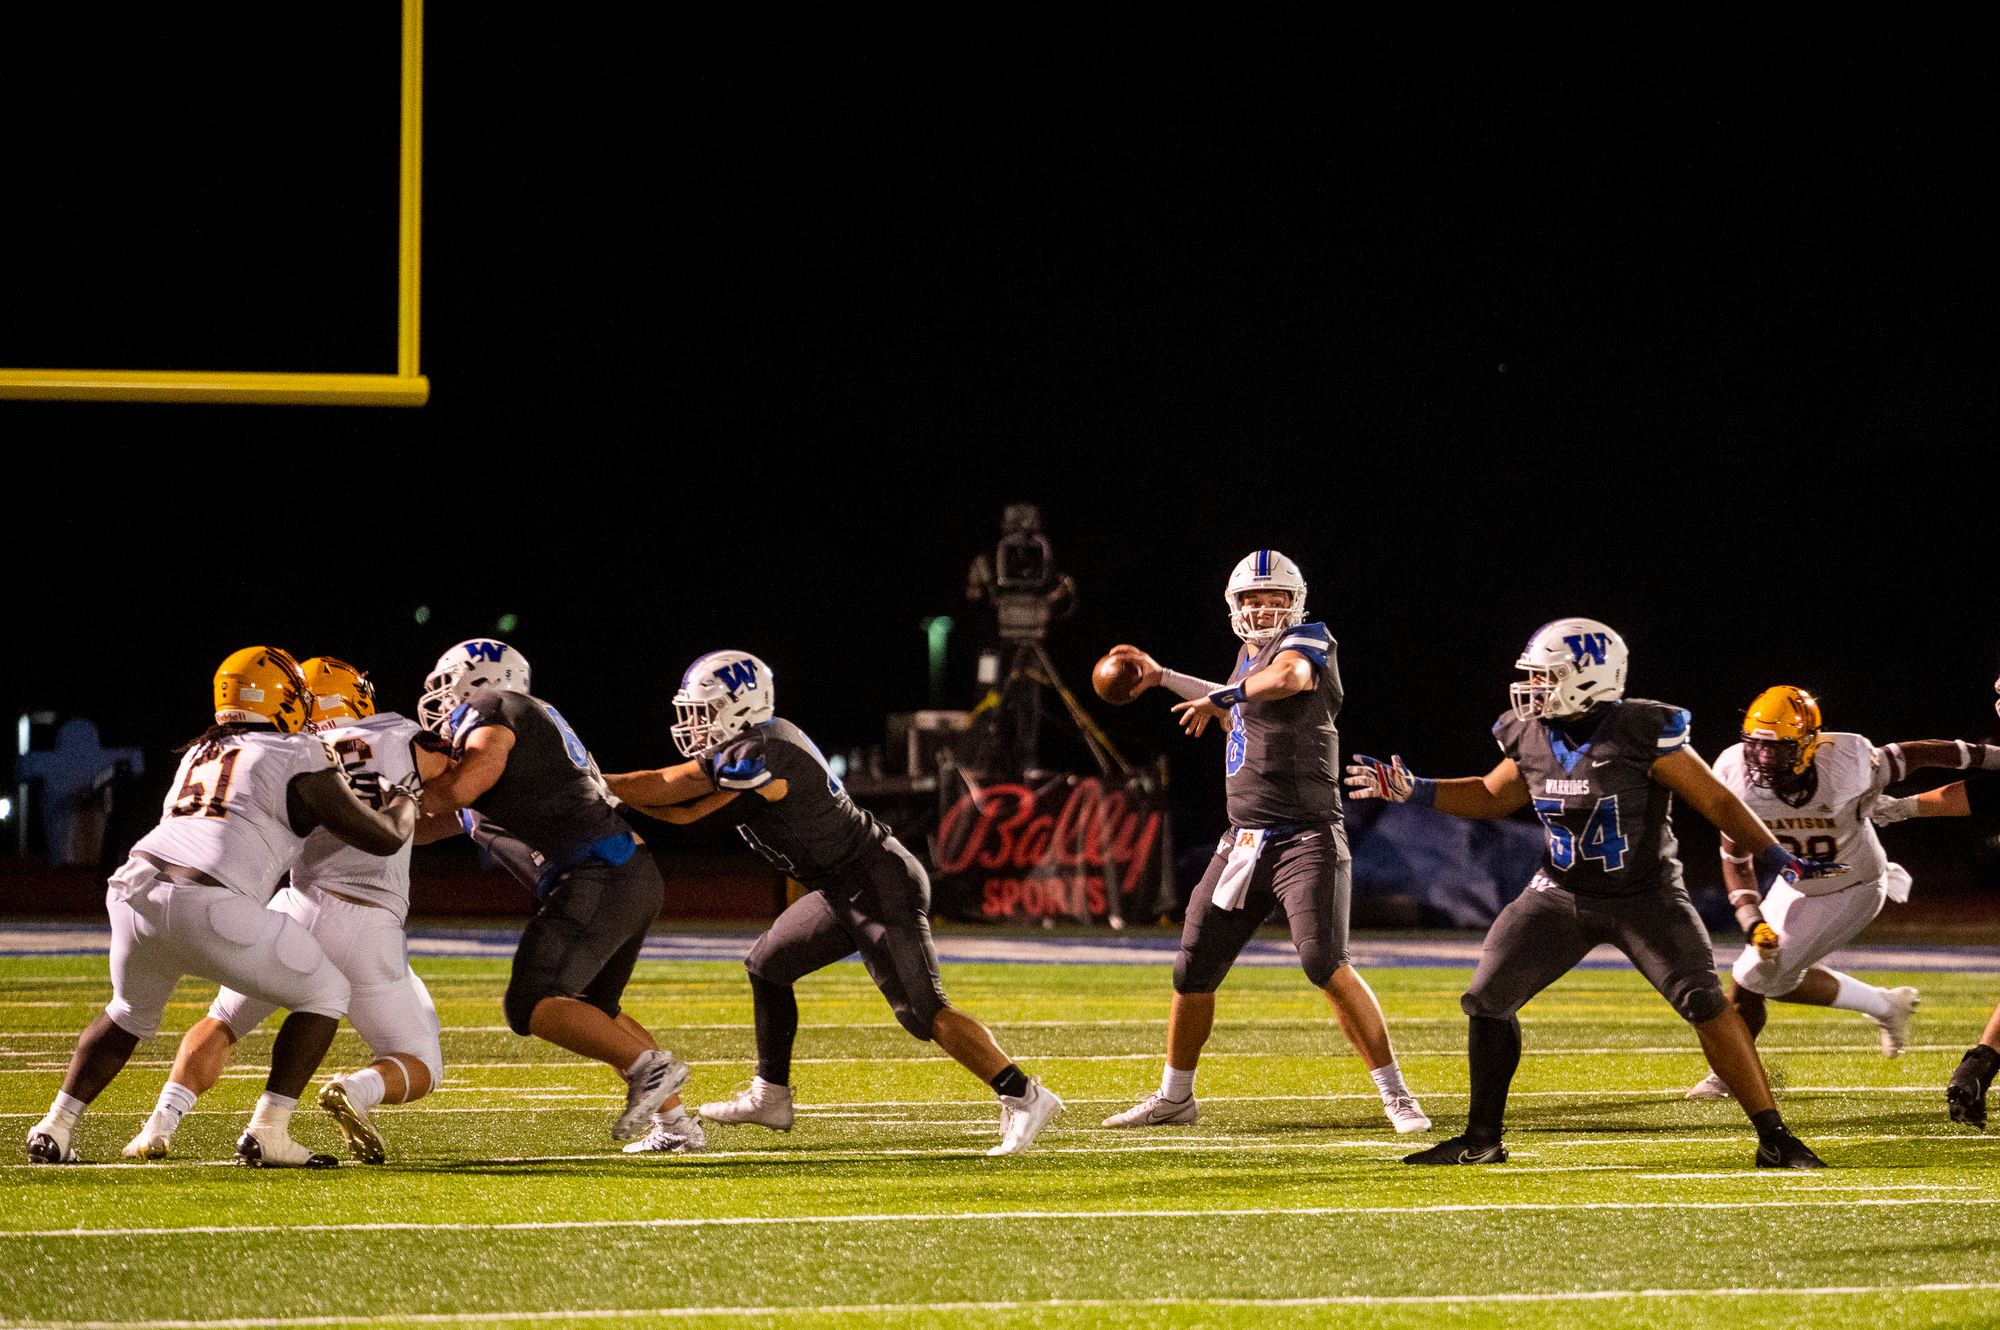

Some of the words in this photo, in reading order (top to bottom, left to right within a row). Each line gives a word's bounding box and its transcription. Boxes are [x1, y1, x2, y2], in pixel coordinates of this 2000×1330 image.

[464, 642, 507, 663] W
[1564, 632, 1609, 667] W
[713, 659, 757, 692] W
[171, 746, 242, 818] 51
[1545, 778, 1591, 795] WARRIORS
[936, 778, 1160, 892] Bally
[1236, 832, 1256, 849] M
[1531, 794, 1629, 872] 54
[982, 877, 1107, 915] SPORTS
